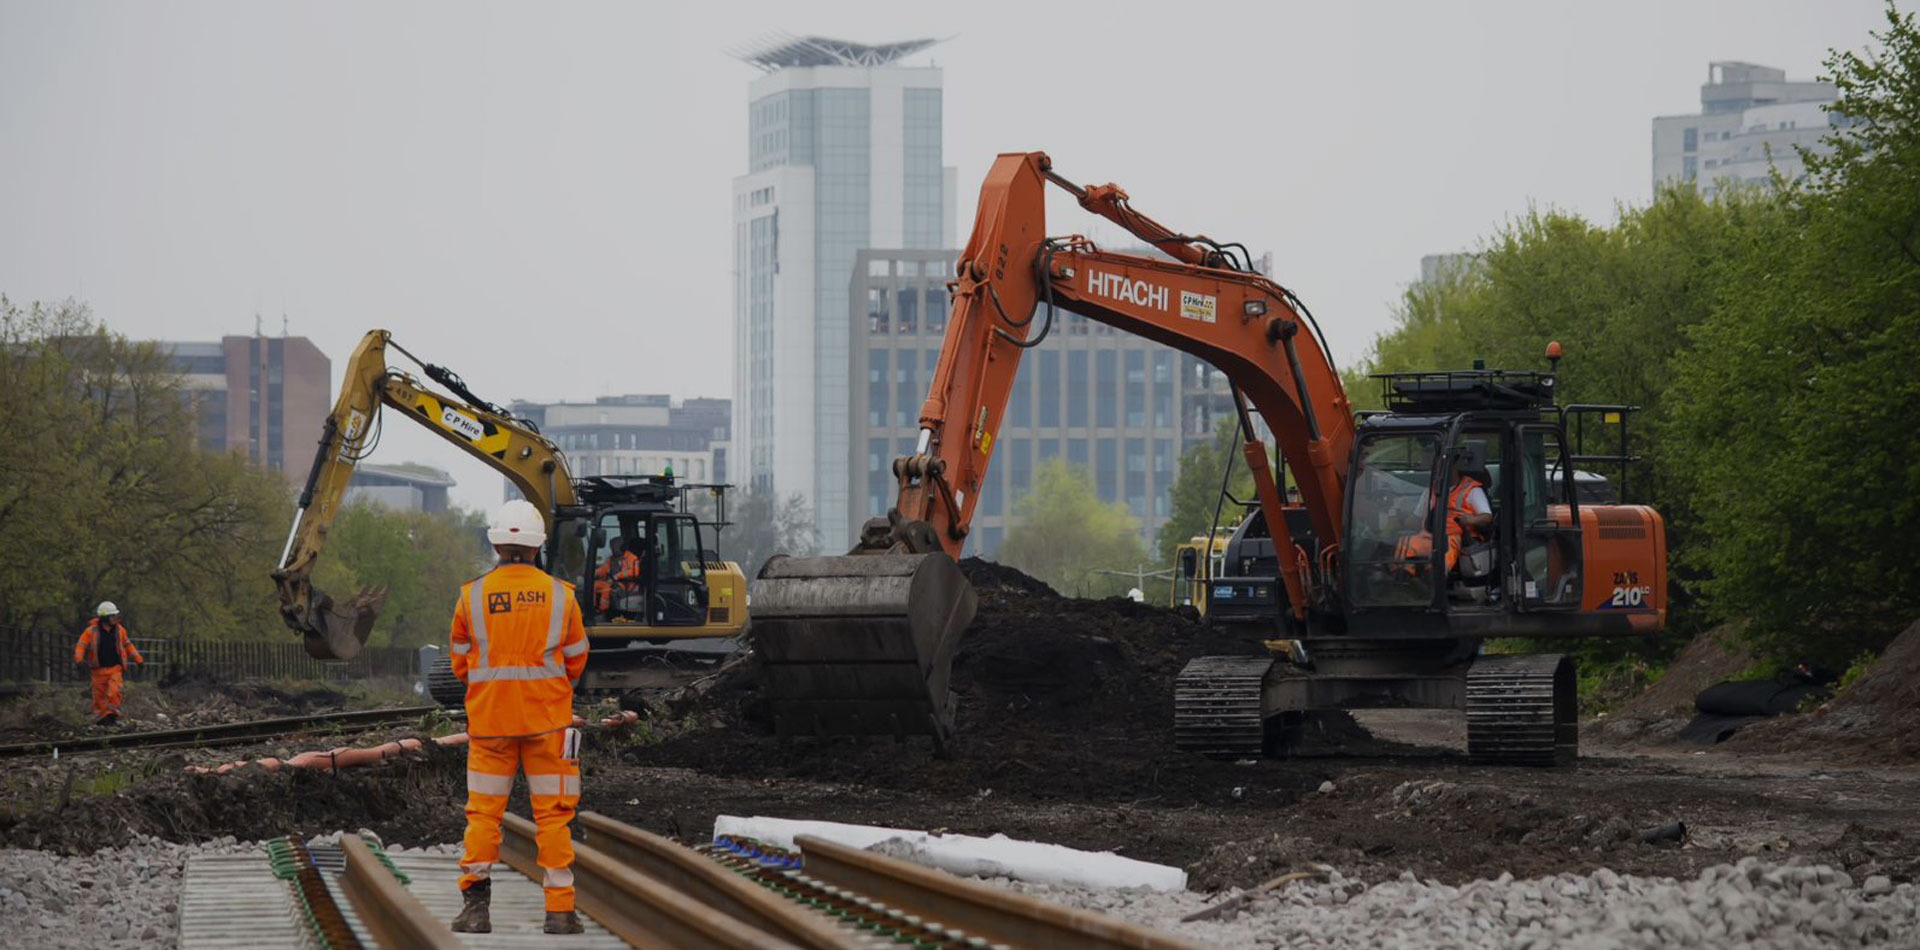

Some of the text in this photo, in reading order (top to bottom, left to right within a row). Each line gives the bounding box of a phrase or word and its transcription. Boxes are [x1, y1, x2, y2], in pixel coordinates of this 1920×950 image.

[1088, 268, 1169, 312] HITACHI
[444, 412, 480, 436] C P Hire
[516, 590, 546, 603] ASH
